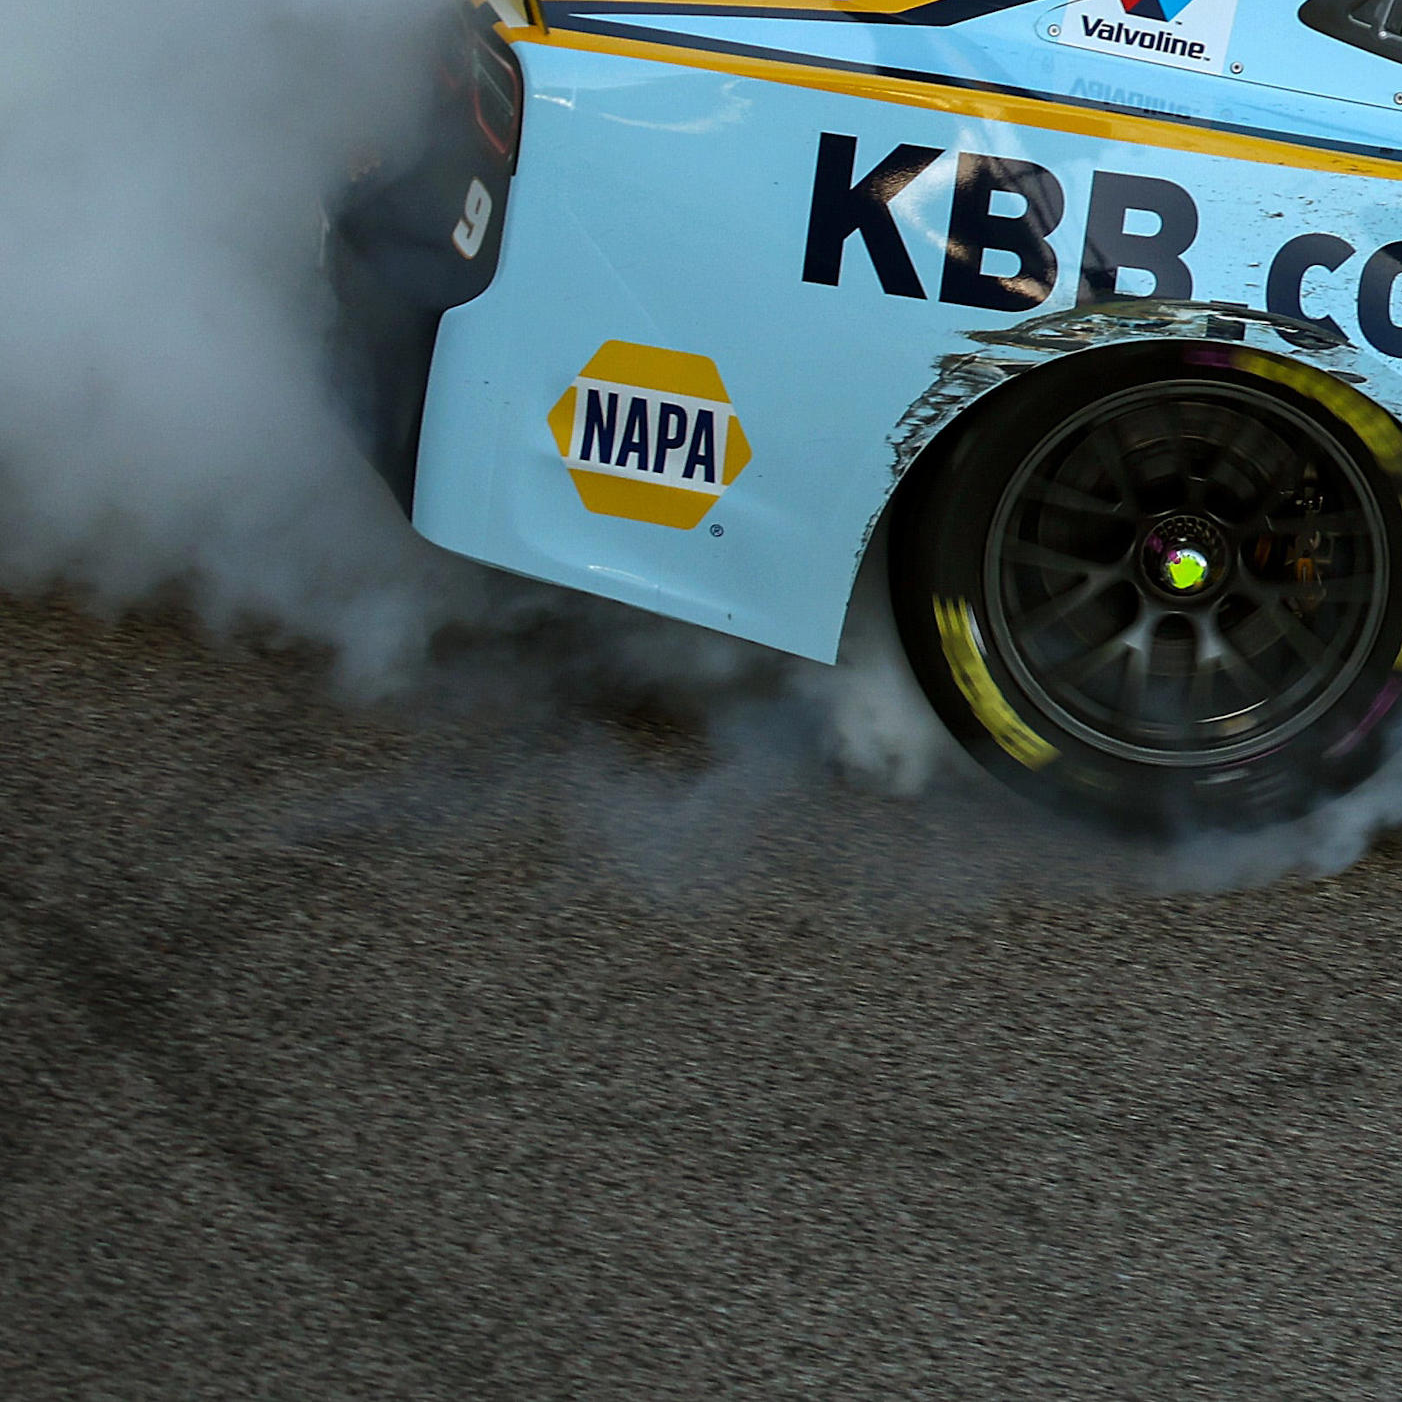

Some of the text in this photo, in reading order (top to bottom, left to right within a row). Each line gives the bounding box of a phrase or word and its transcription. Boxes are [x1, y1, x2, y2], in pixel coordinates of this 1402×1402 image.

[1081, 14, 1206, 59] Valvoline
[452, 176, 493, 260] 9
[579, 388, 716, 484] NAPA
